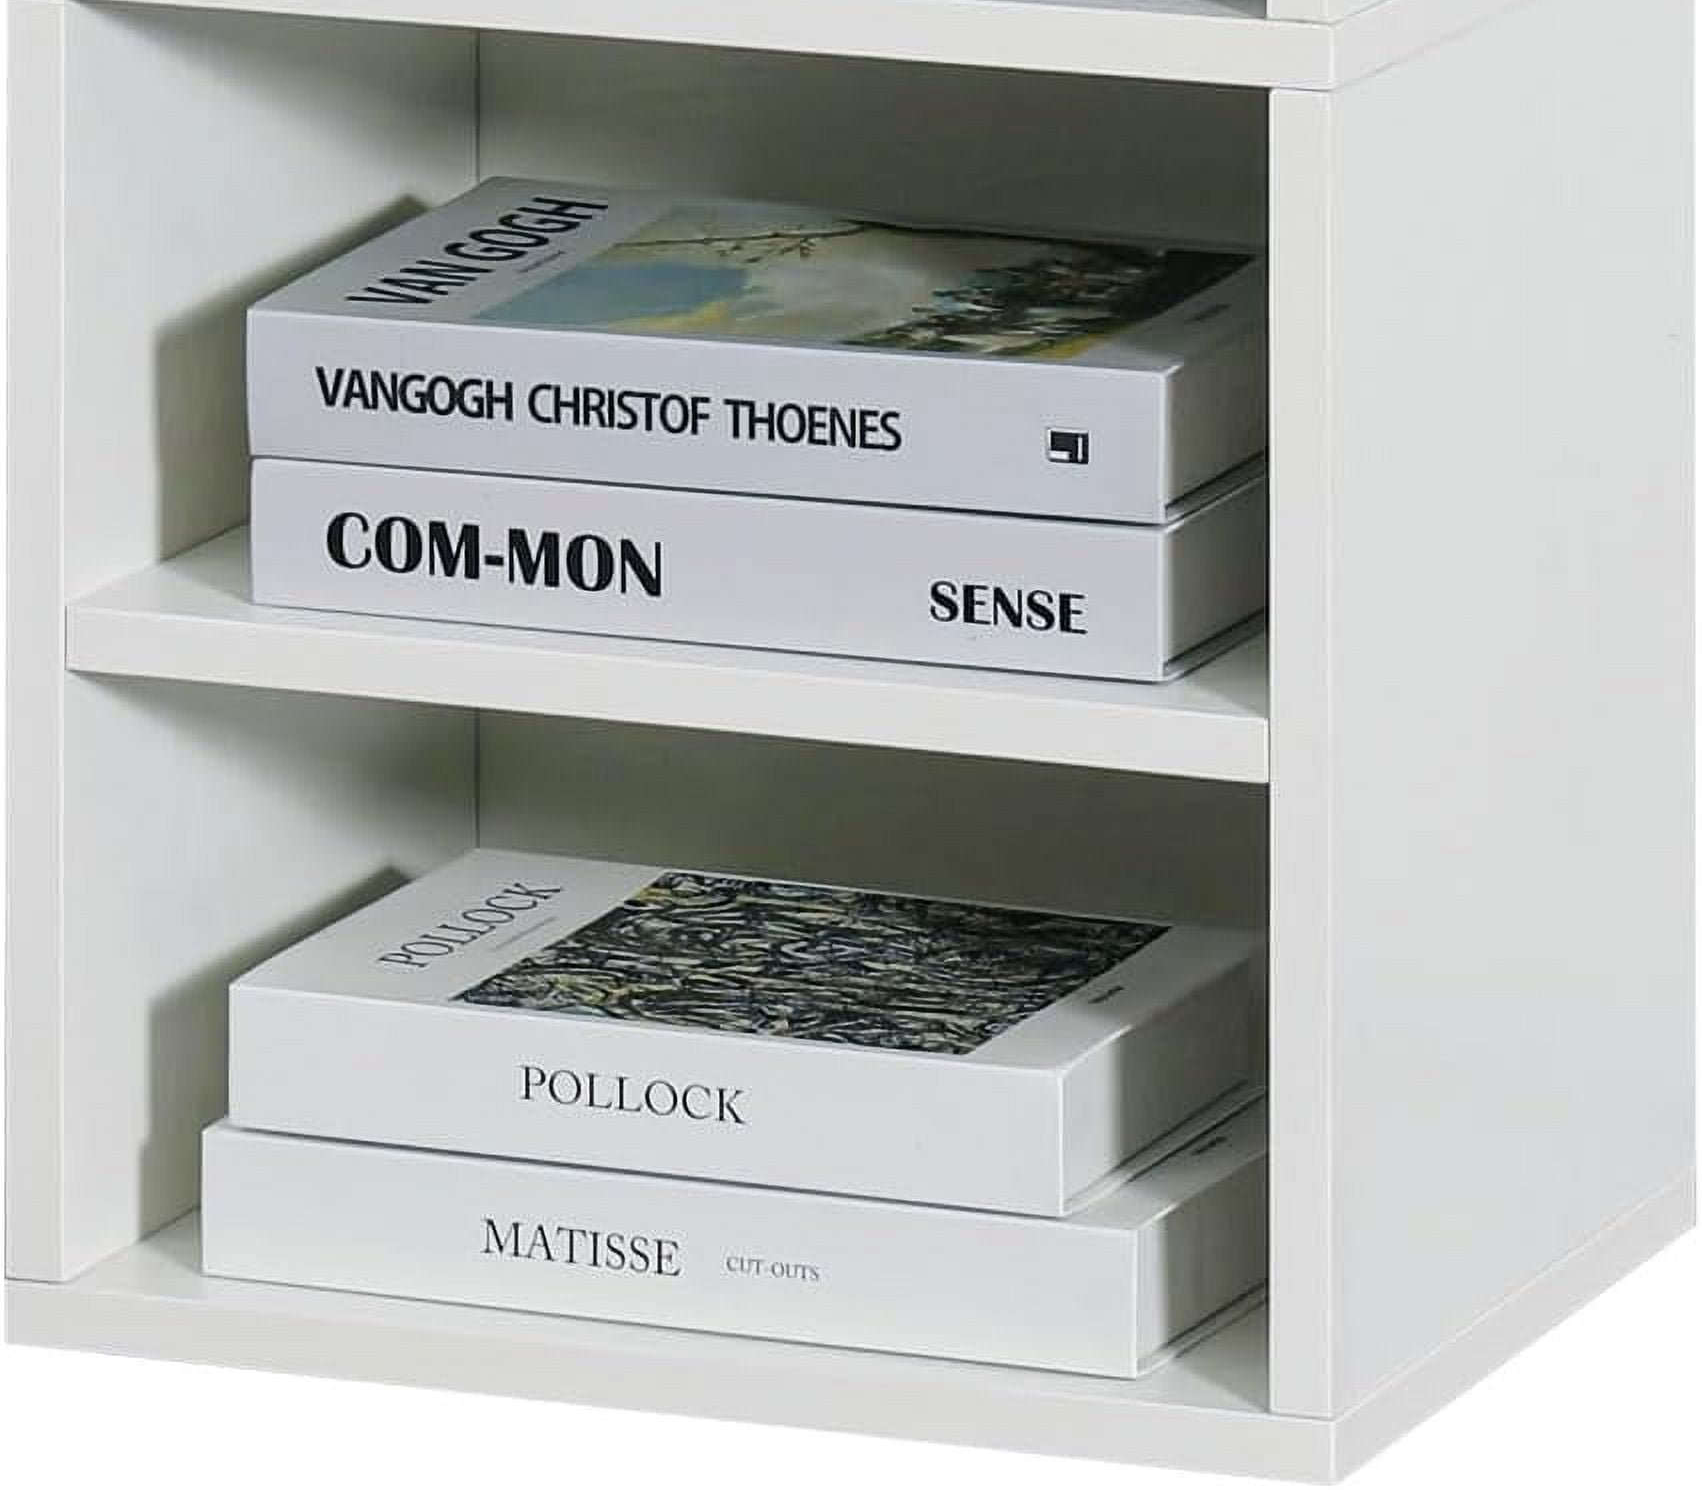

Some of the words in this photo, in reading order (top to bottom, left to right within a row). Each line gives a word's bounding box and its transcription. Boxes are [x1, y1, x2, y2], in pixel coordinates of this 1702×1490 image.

[346, 260, 494, 304] VAN
[445, 197, 608, 261] GOGH
[316, 366, 513, 421] VANGOGH
[528, 384, 710, 435] CHRISTOF
[724, 399, 901, 451] THOENES
[327, 512, 661, 597] COM-MON
[930, 581, 1087, 634] SENSE
[378, 883, 563, 968] POLLOCK
[520, 1066, 744, 1124] POLLOCK
[480, 1219, 679, 1276] MATISSE
